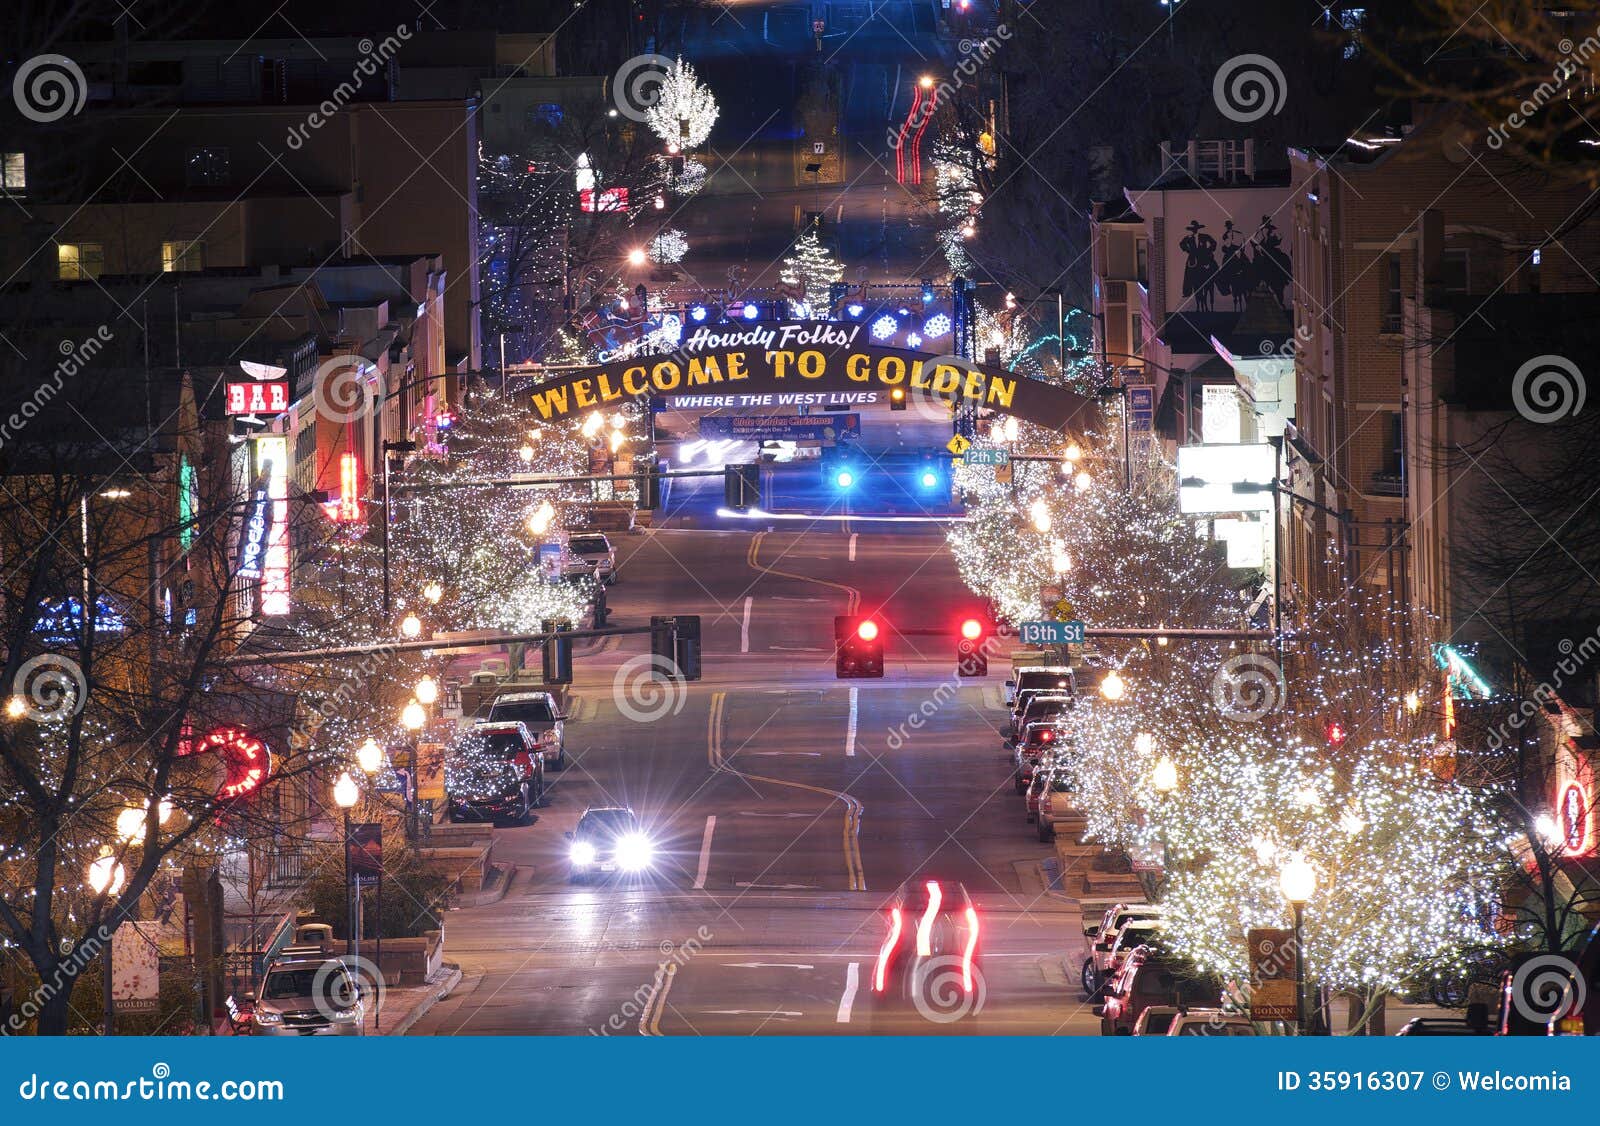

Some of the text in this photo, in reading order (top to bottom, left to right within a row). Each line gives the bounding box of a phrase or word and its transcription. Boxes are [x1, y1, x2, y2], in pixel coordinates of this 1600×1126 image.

[687, 324, 860, 351] Howdy Folks!
[531, 351, 749, 419] WELCOME
[765, 350, 827, 379] TO
[846, 353, 1017, 409] GOLDEN
[230, 384, 287, 411] BAR
[675, 392, 878, 408] WHERE THE WEST LIVES
[966, 451, 1008, 464] 12th St
[1023, 624, 1081, 641] 13th St
[116, 1000, 156, 1009] GOLDEN
[1254, 1007, 1294, 1015] GOLDEN
